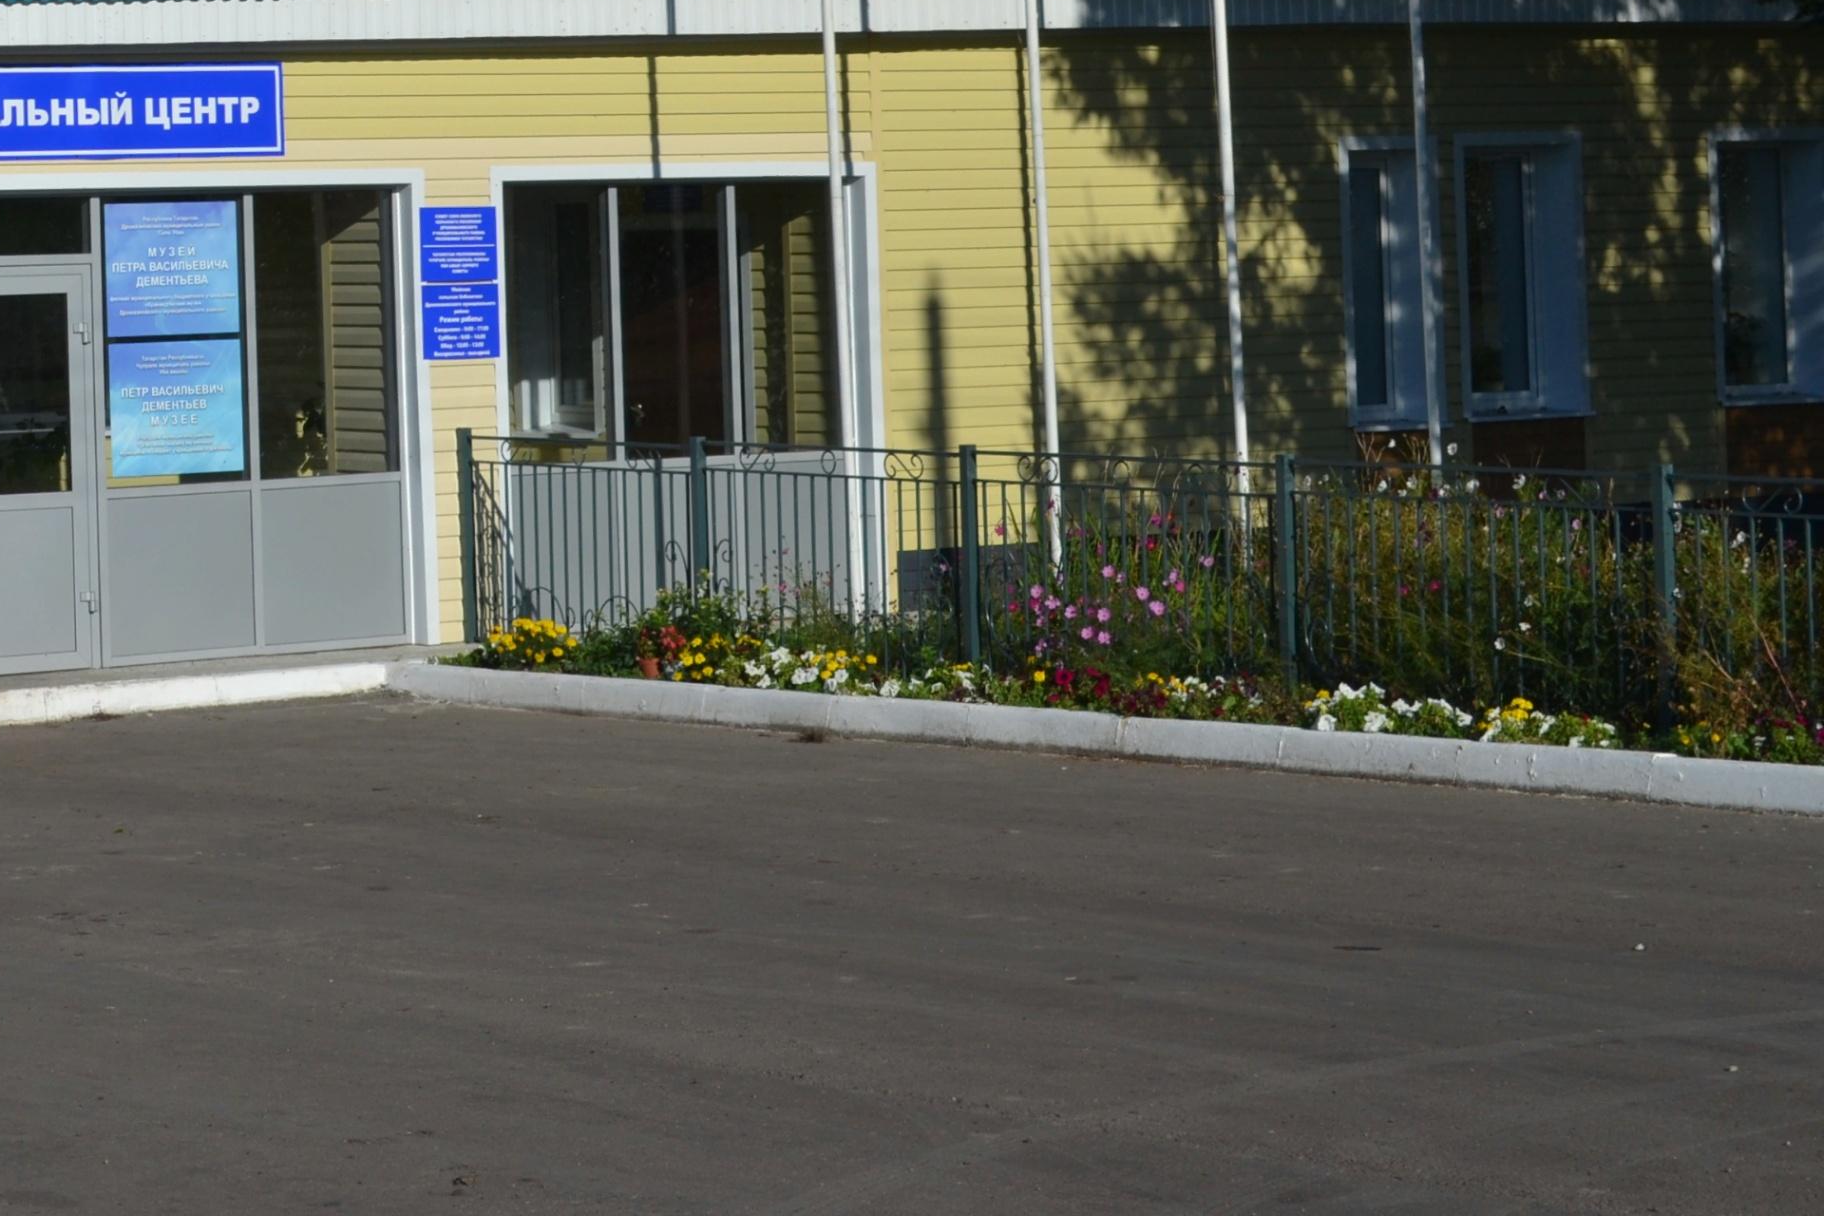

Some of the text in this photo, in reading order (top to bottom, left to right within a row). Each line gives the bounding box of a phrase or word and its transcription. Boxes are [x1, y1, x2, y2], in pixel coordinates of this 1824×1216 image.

[144, 96, 260, 129] ЦЕНТР
[112, 259, 230, 273] ПЕТРА ВАСИЛЬЕВИЧА
[136, 274, 209, 288] ДЕМЕНТЬЕВА
[121, 384, 224, 398] ПЕТР ВАСИЛЬЕВИЧ
[141, 399, 207, 413] ДЕМЕНТЬЕВ
